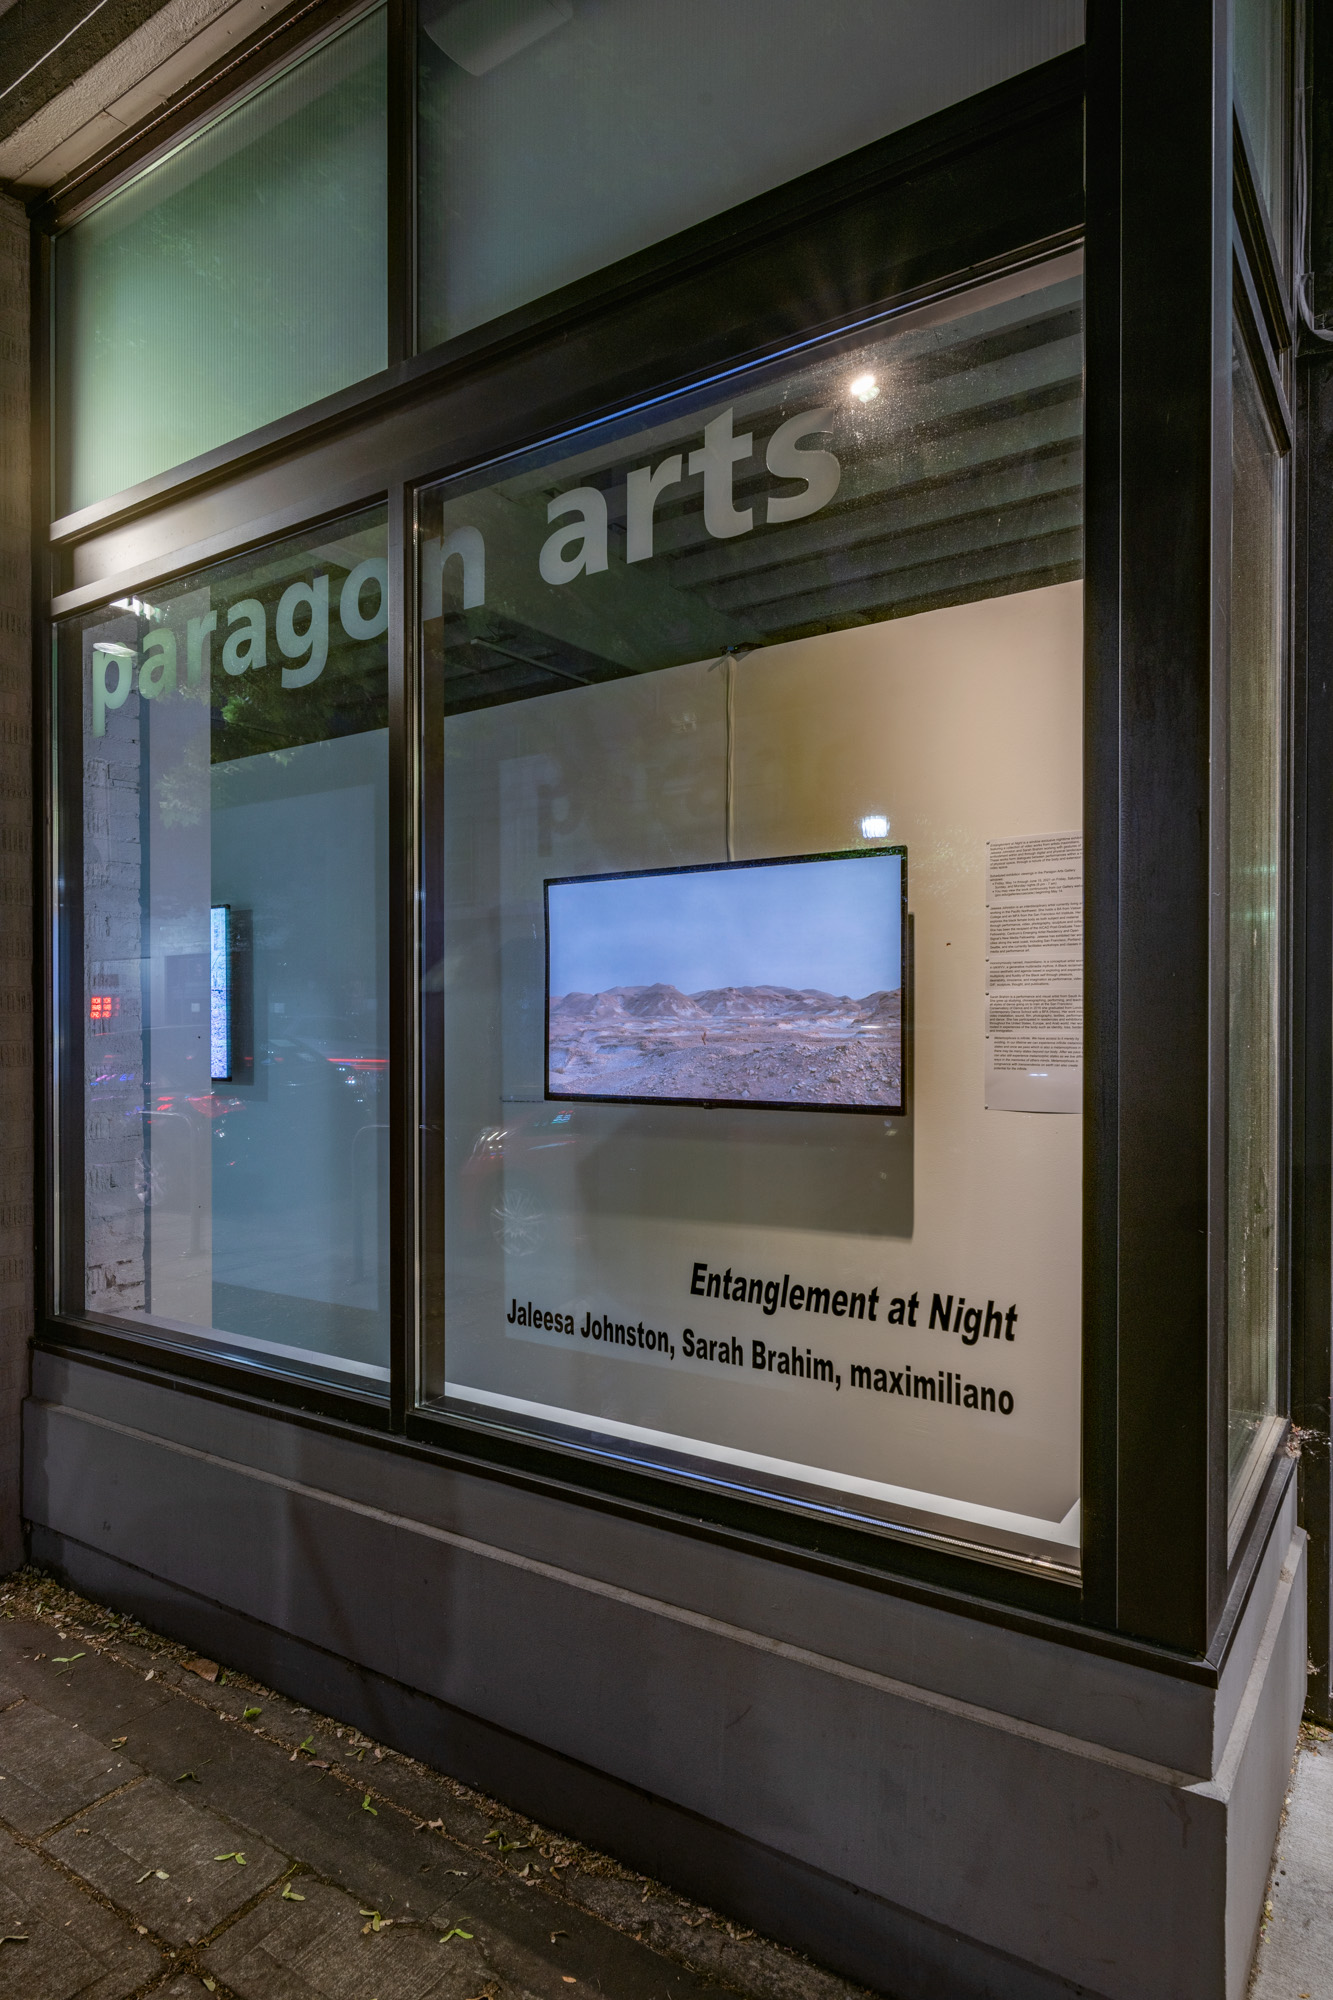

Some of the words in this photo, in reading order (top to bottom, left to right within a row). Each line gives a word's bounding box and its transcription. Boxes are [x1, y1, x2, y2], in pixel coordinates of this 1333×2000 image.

[91, 524, 486, 737] paragon
[539, 406, 841, 587] arts
[507, 1299, 575, 1335] Jaleesa
[580, 1312, 676, 1360] Johnston,
[682, 1328, 744, 1366] Sarah
[752, 1340, 842, 1391] Brahim,
[850, 1362, 1015, 1416] maximiliano
[690, 1262, 879, 1322] Entanglement
[888, 1289, 917, 1327] at
[929, 1293, 1018, 1346] Night
